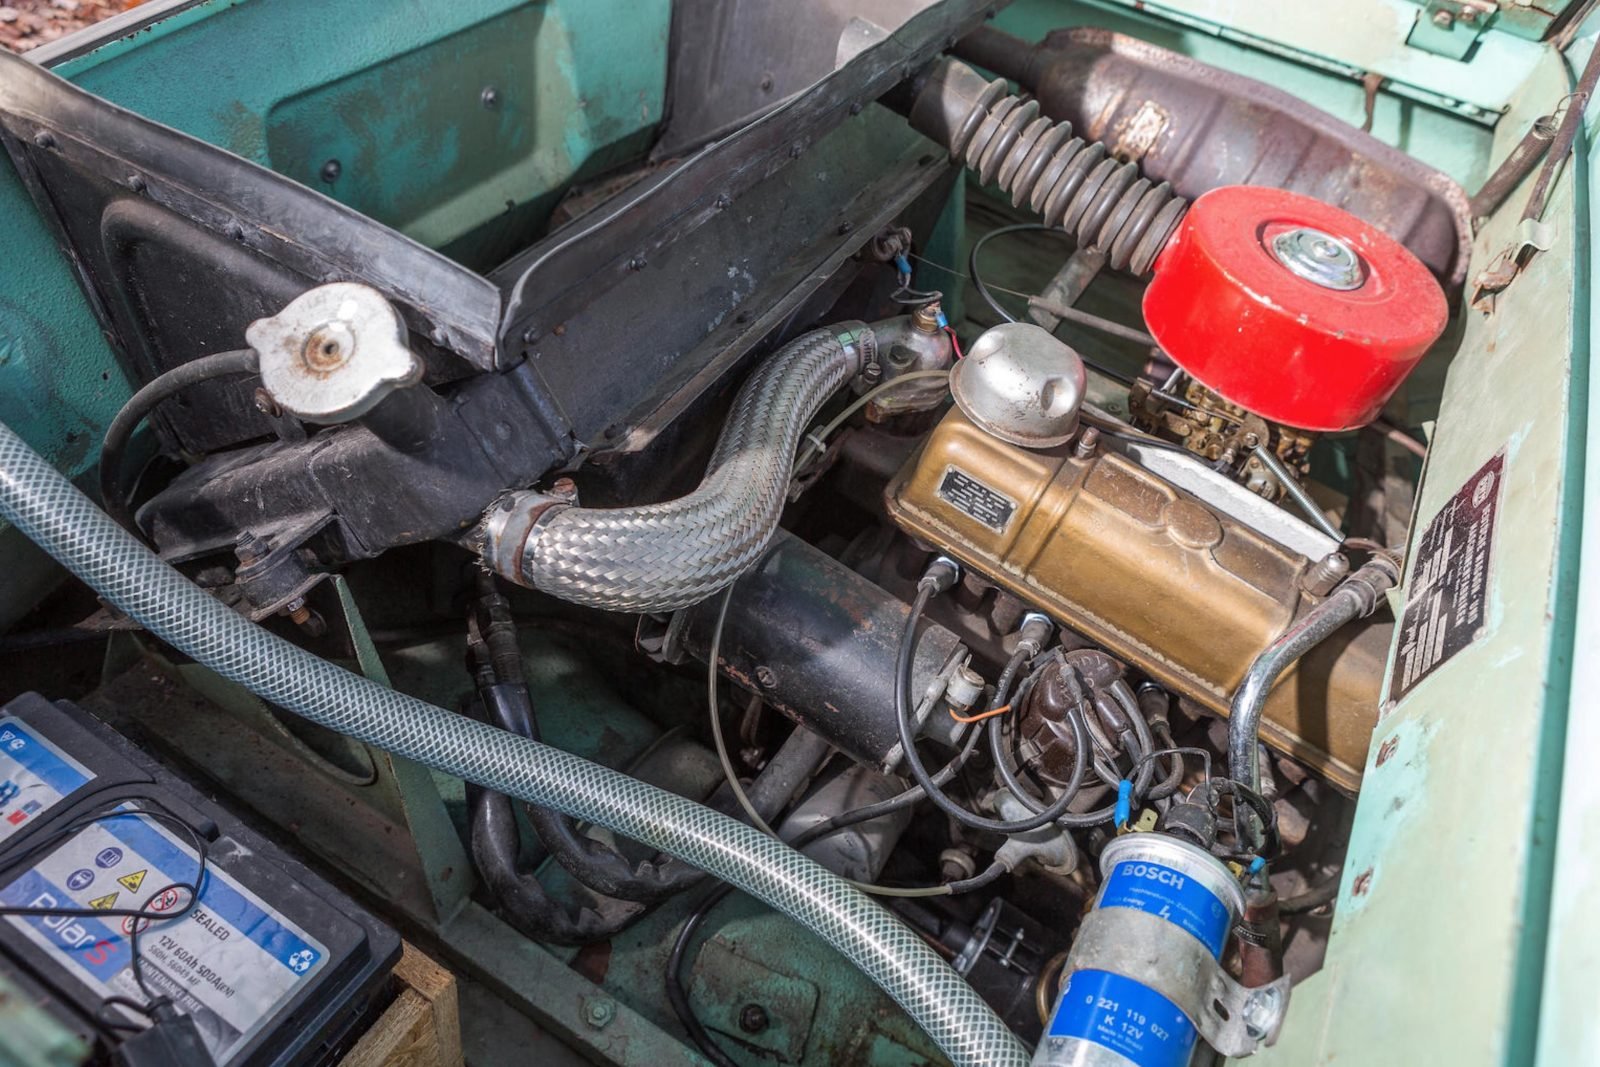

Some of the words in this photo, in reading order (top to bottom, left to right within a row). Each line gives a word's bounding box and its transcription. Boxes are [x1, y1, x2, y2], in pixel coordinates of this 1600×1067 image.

[1122, 864, 1185, 890] BOSCH
[190, 908, 231, 942] SEALED
[158, 935, 178, 951] 12V
[173, 947, 199, 970] 60Ah
[181, 995, 203, 1014] FREE
[1085, 995, 1092, 1004] 0
[1098, 997, 1118, 1011] 221
[1150, 1023, 1170, 1041] 027
[1104, 1015, 1114, 1026] K
[1122, 1023, 1144, 1040] 12V
